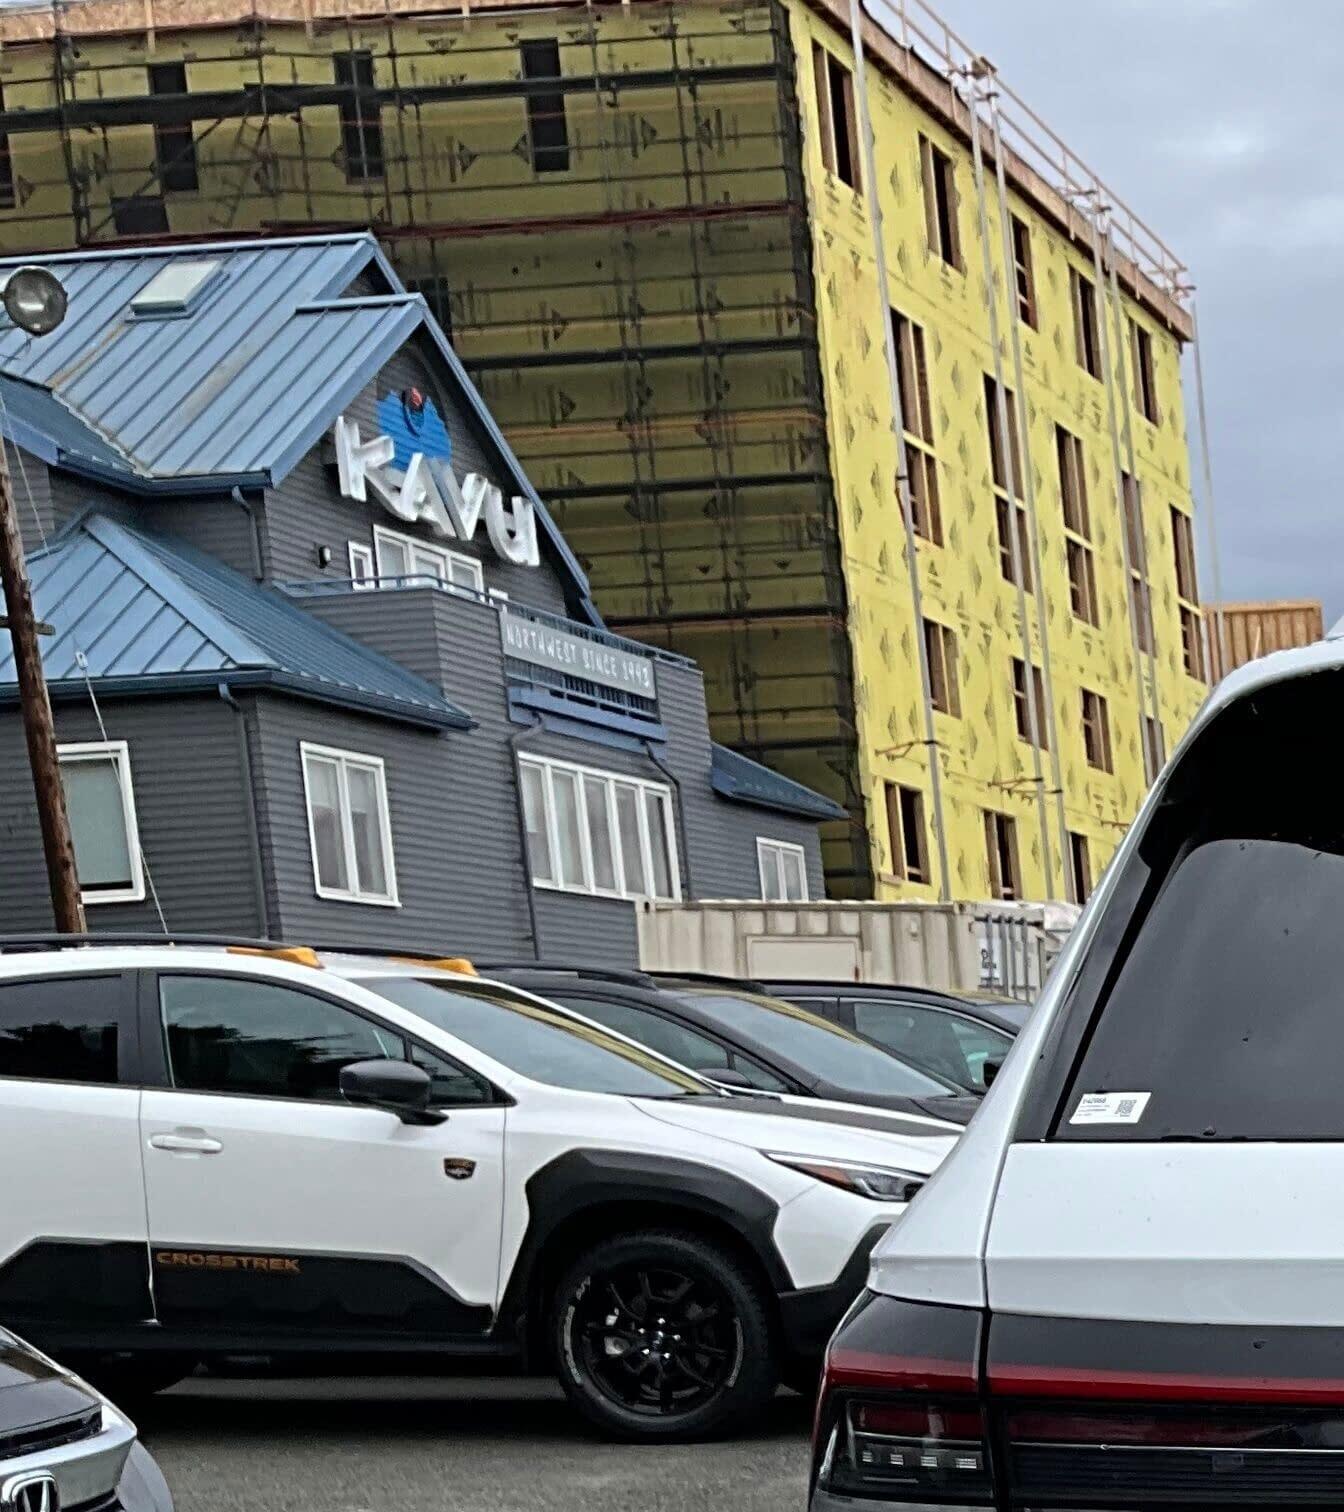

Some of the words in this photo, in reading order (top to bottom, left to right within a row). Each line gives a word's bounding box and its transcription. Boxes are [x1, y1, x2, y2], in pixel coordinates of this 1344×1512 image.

[335, 416, 539, 566] KAVU
[506, 623, 576, 664] NORTHWEST
[582, 647, 617, 677] SINCE
[156, 1252, 300, 1273] CROSSTREK
